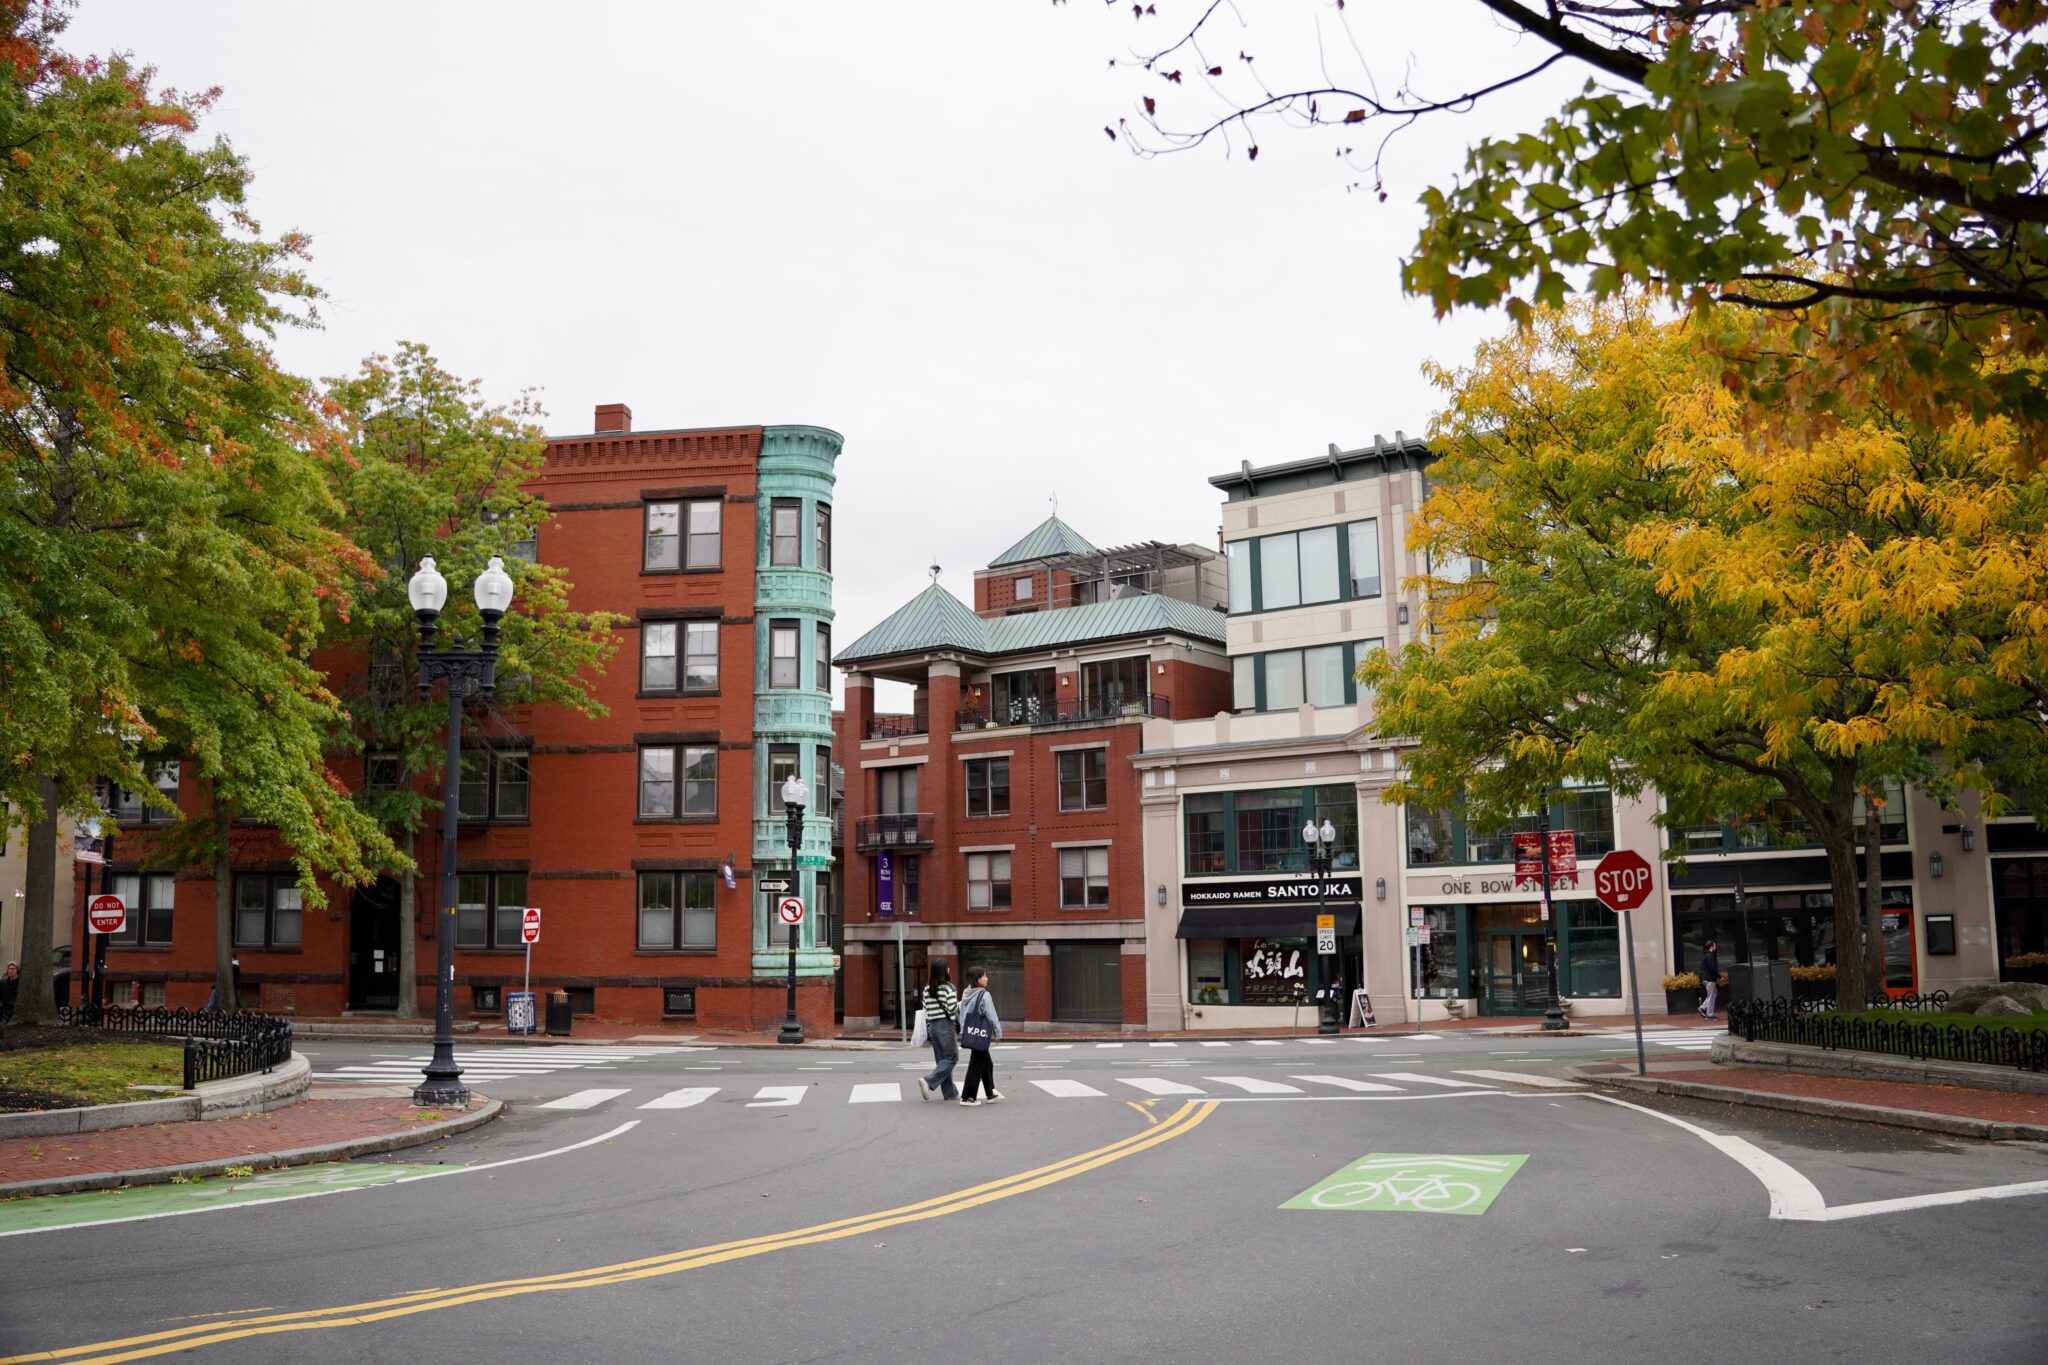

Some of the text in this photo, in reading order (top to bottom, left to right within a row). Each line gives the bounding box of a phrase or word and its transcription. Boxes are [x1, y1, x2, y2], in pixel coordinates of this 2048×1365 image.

[883, 858, 889, 869] 3
[1598, 867, 1649, 894] STOP
[1442, 882, 1472, 895] ONE
[1481, 880, 1513, 893] BOW
[1190, 892, 1231, 900] HOKKAIDO
[1233, 891, 1262, 899] RAMEN
[1319, 940, 1334, 951] 20
